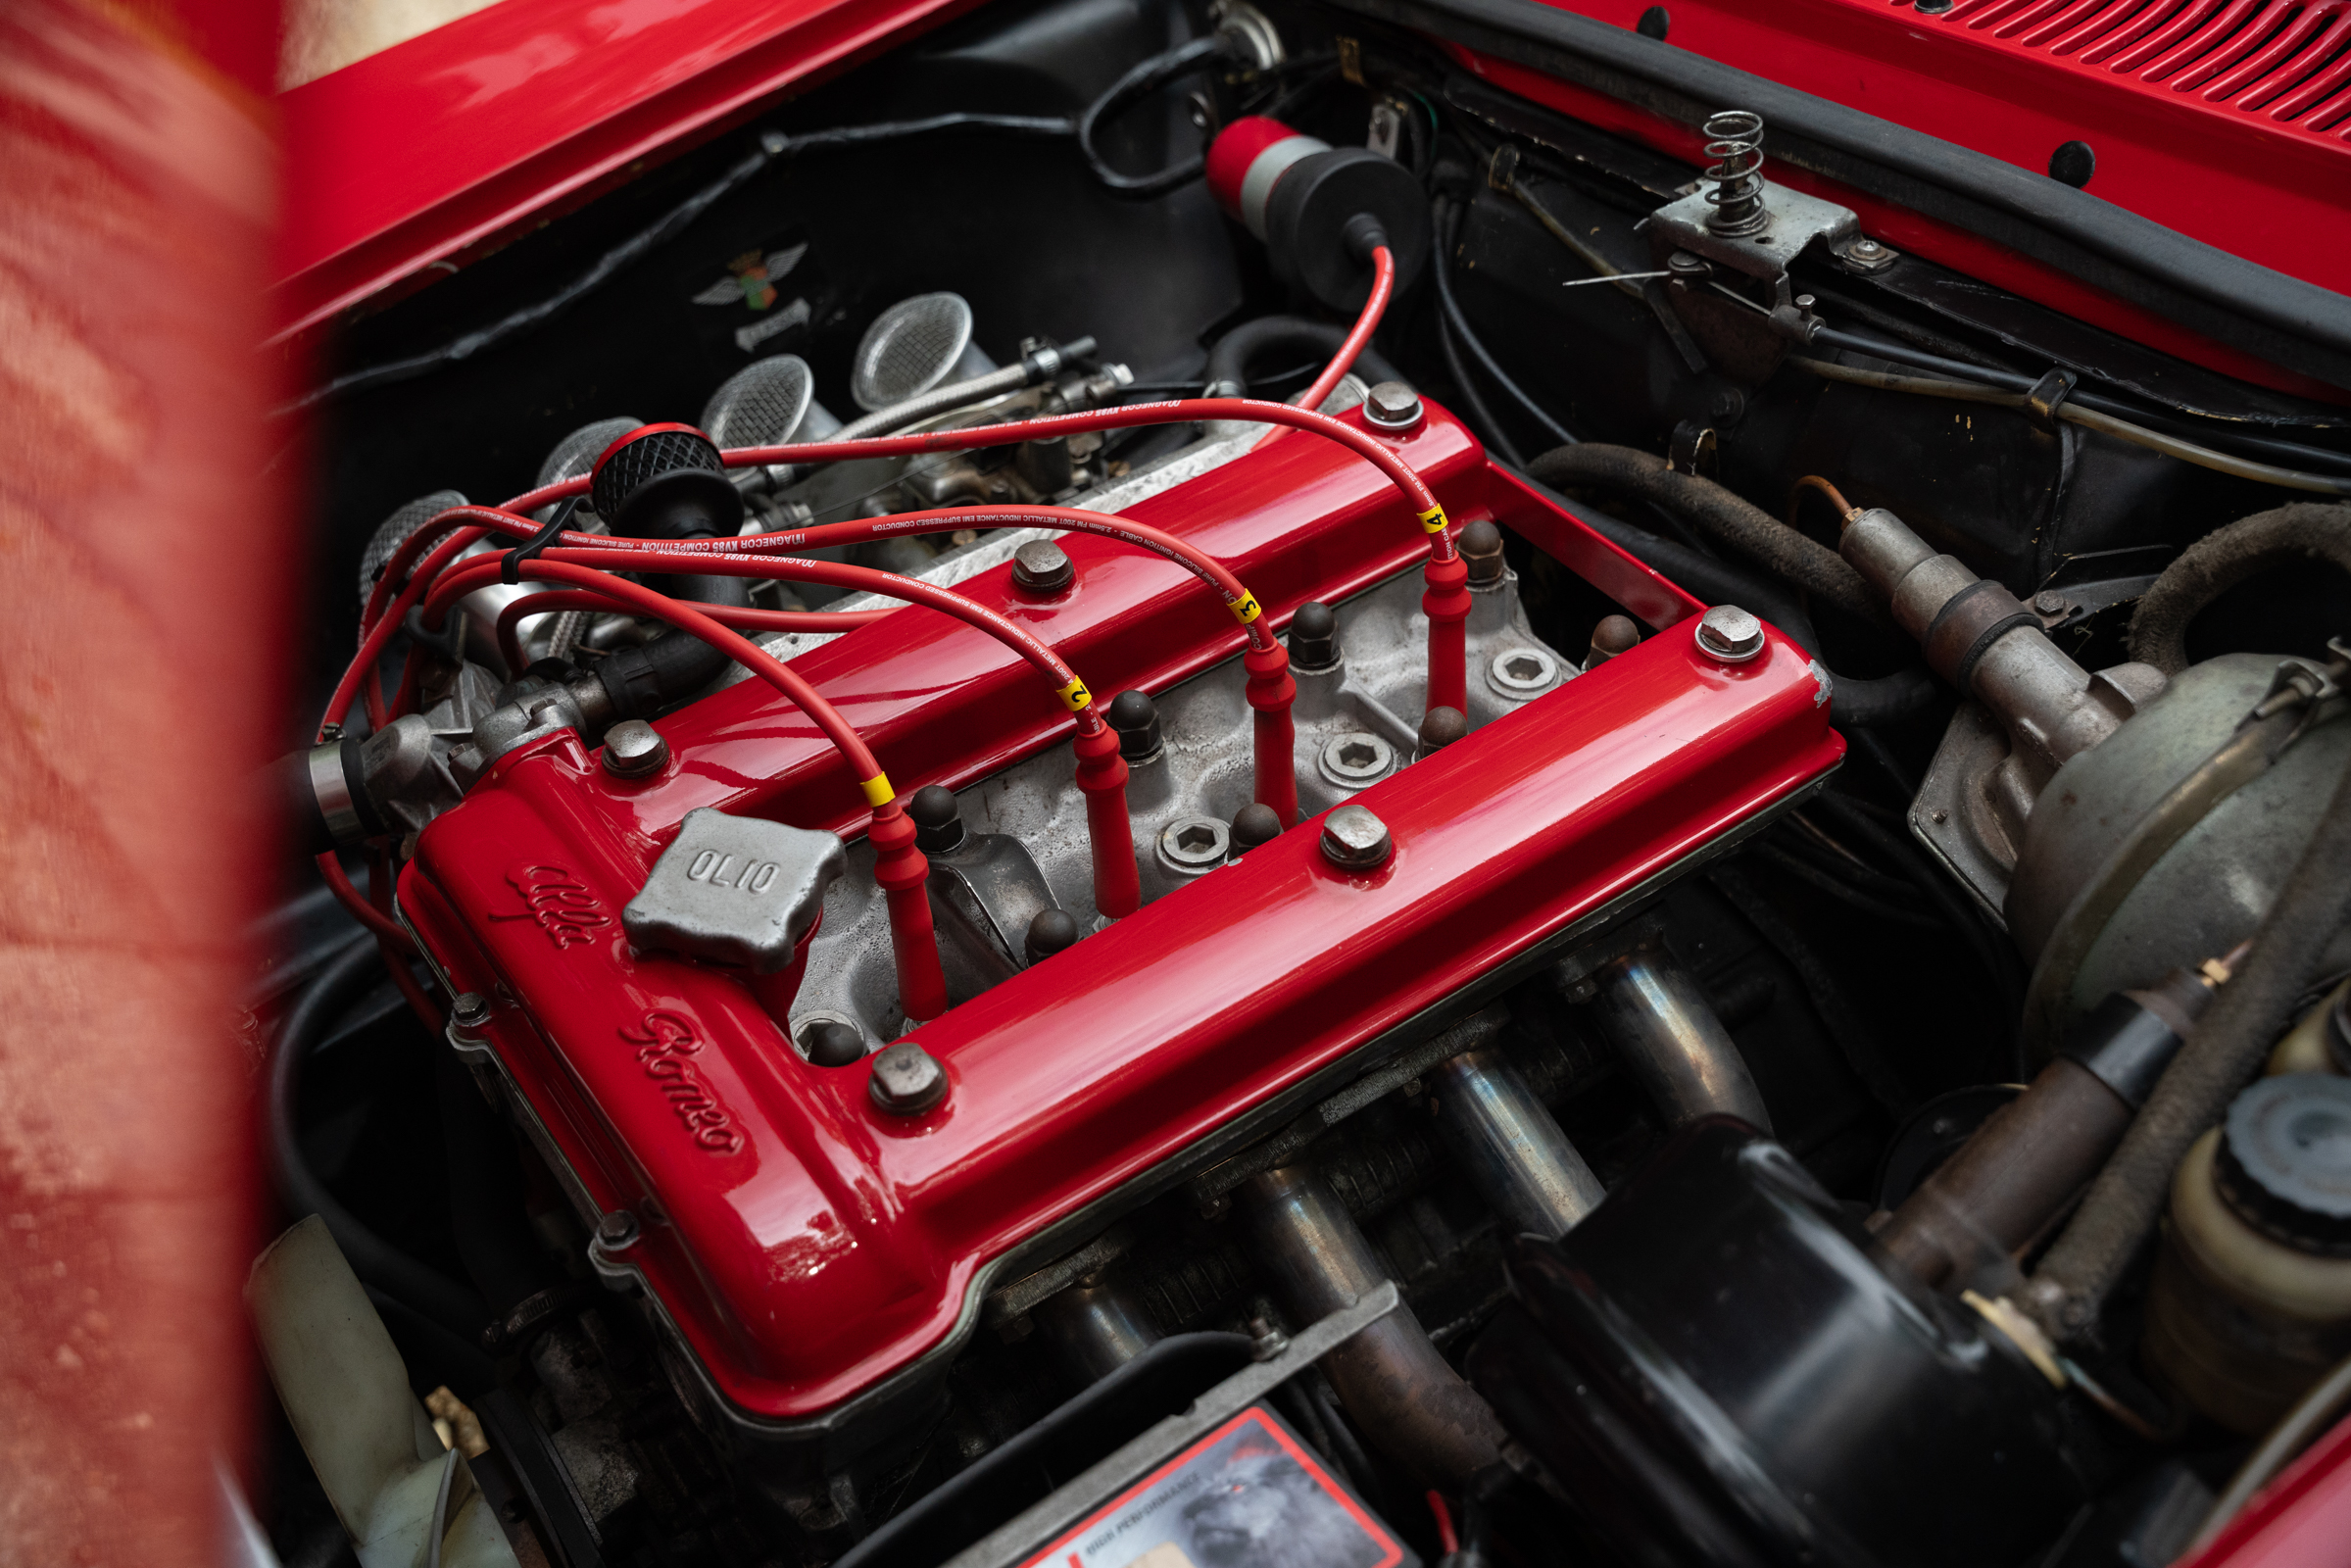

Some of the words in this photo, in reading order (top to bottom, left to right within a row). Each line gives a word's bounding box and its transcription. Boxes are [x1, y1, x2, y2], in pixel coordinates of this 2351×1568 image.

[1121, 399, 1182, 412] MAGNECOR
[1242, 399, 1282, 409] CONDUCTOR
[1029, 410, 1094, 425] COMPETITION
[1282, 404, 1323, 420] SUPPRESSED
[1323, 416, 1337, 424] EMI
[1336, 420, 1376, 446] INDUCTANCE
[1375, 444, 1404, 468] METALLIC
[1402, 467, 1417, 482] 200T
[872, 520, 915, 532] CONDUCTOR
[916, 515, 961, 526] SUPPRESSED
[1022, 515, 1057, 524] METALLIC
[1427, 513, 1443, 525] 4
[1089, 522, 1112, 533] 2.5mm
[741, 533, 806, 549] MAGNECOR
[1119, 530, 1144, 543] CABLE
[641, 541, 710, 553] COMPETITION
[712, 540, 739, 552] KV85
[1144, 538, 1174, 556] IGNITION
[723, 552, 751, 562] KV85
[751, 554, 817, 567] MAGNECOR
[1174, 552, 1203, 574] SILICONE
[881, 572, 925, 589] CONDUCTOR
[1201, 571, 1219, 587] PURE
[925, 585, 971, 607] SUPPRESSED
[969, 603, 984, 614] EMI
[1240, 600, 1256, 617] 3
[983, 610, 1027, 640] INDUCTANCE
[1025, 637, 1057, 666] METALLIC
[1054, 665, 1071, 680] 200T
[1071, 684, 1088, 703] 2
[687, 849, 781, 895] OLIO
[488, 865, 612, 950] Alfa
[617, 1011, 745, 1157] Romeo
